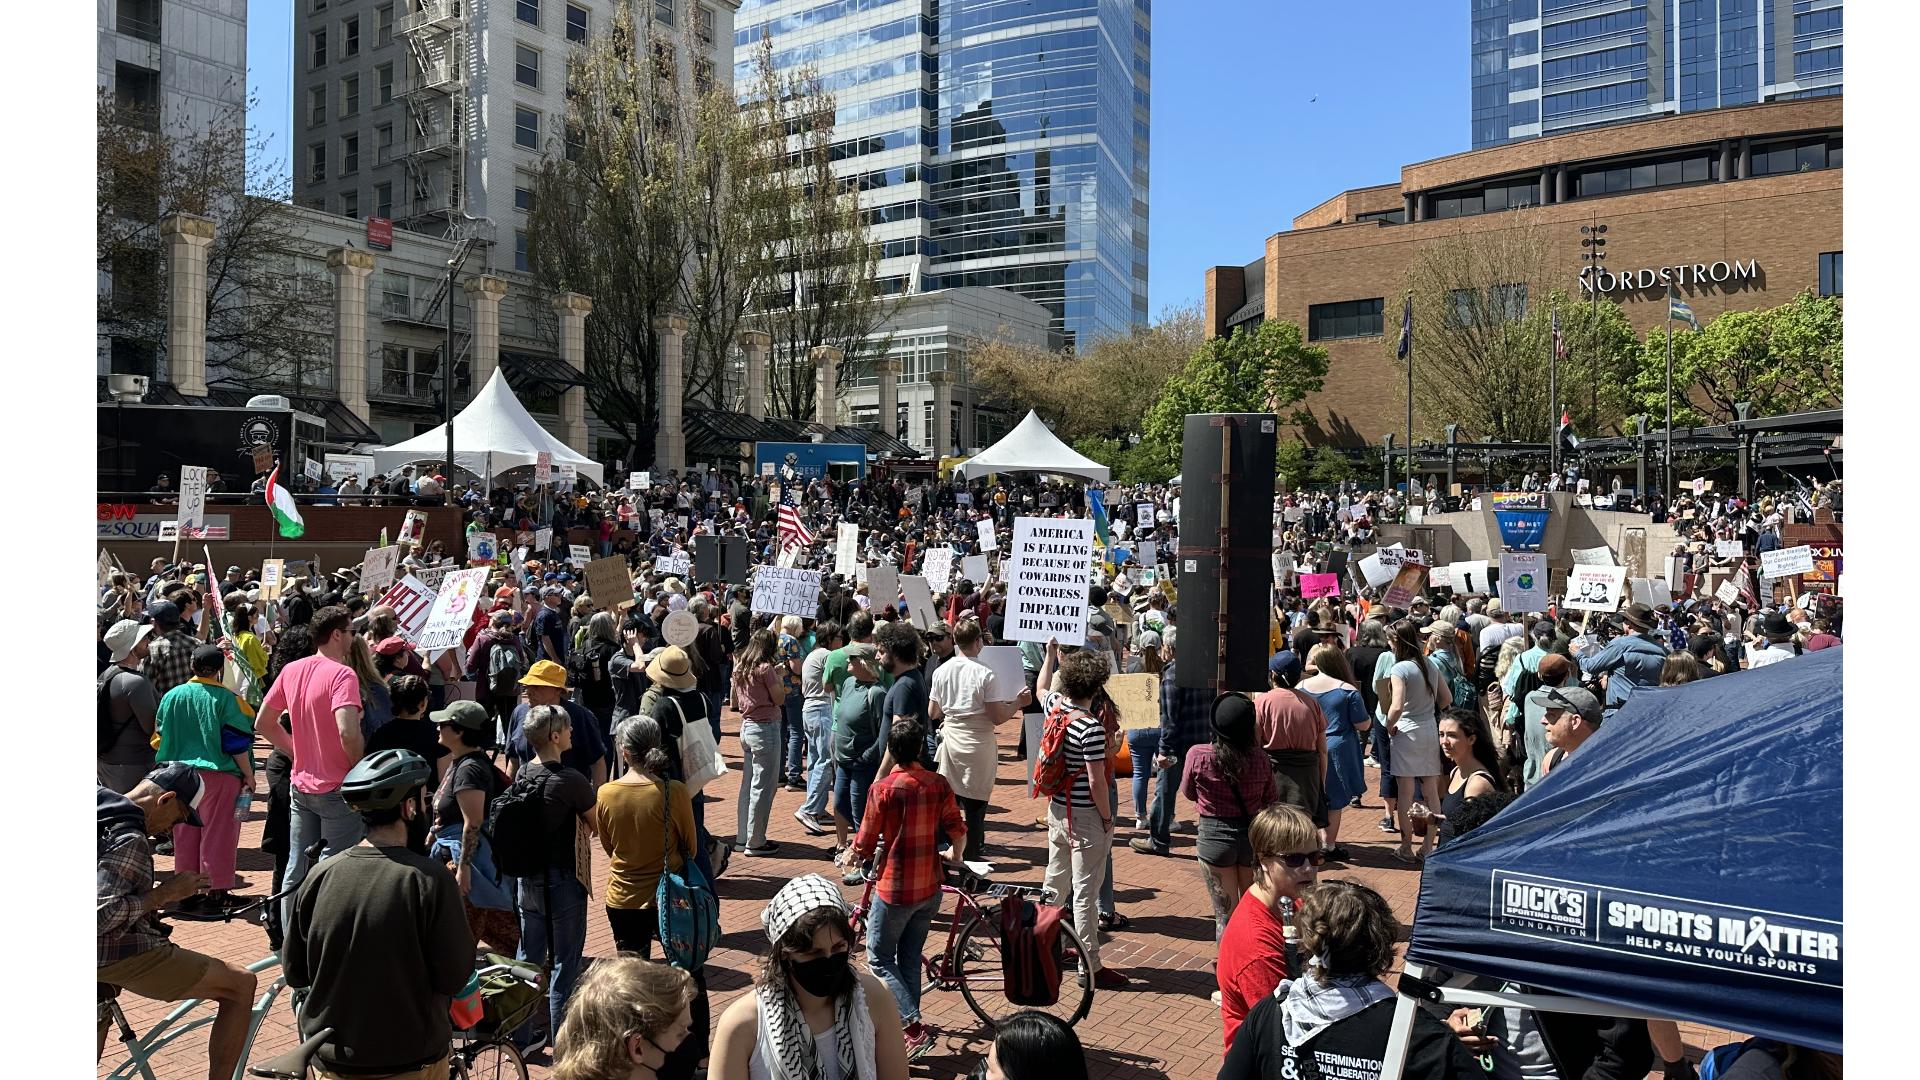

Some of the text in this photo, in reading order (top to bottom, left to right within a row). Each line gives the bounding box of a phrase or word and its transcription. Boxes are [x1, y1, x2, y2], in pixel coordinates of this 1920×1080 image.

[1579, 258, 1757, 293] NORDSTROM
[183, 468, 206, 481] LOCK
[183, 482, 206, 496] THEM
[186, 497, 200, 510] UP
[112, 521, 160, 538] SQUA
[1030, 527, 1084, 540] AMERICA
[1023, 543, 1088, 556] IS FALLING
[1381, 548, 1393, 556] NO
[1405, 549, 1419, 558] NO
[1022, 557, 1087, 570] BECAUSE OF
[420, 569, 439, 579] THEY
[758, 566, 822, 584] REBELLIONS
[1019, 571, 1087, 584] COWARDS IN
[426, 577, 445, 588] CAR
[755, 580, 819, 599] ARE BUILT
[1018, 585, 1084, 600] CONGRESS.
[756, 593, 818, 616] ON HOPE
[1019, 602, 1080, 617] IMPEACH
[426, 618, 468, 629] EARN THEIR
[1018, 618, 1078, 633] HIM NOW!
[1506, 882, 1583, 917] DICK'S
[1506, 906, 1550, 920] SPORTING
[1501, 916, 1587, 937] FOUNDATION
[1608, 900, 1839, 960] SPORTS MATTER
[1625, 935, 1817, 975] HELP SAVE YOUTH SPORTS
[1281, 1045, 1384, 1071] SEL ETERMINATION
[1280, 1058, 1300, 1080] &
